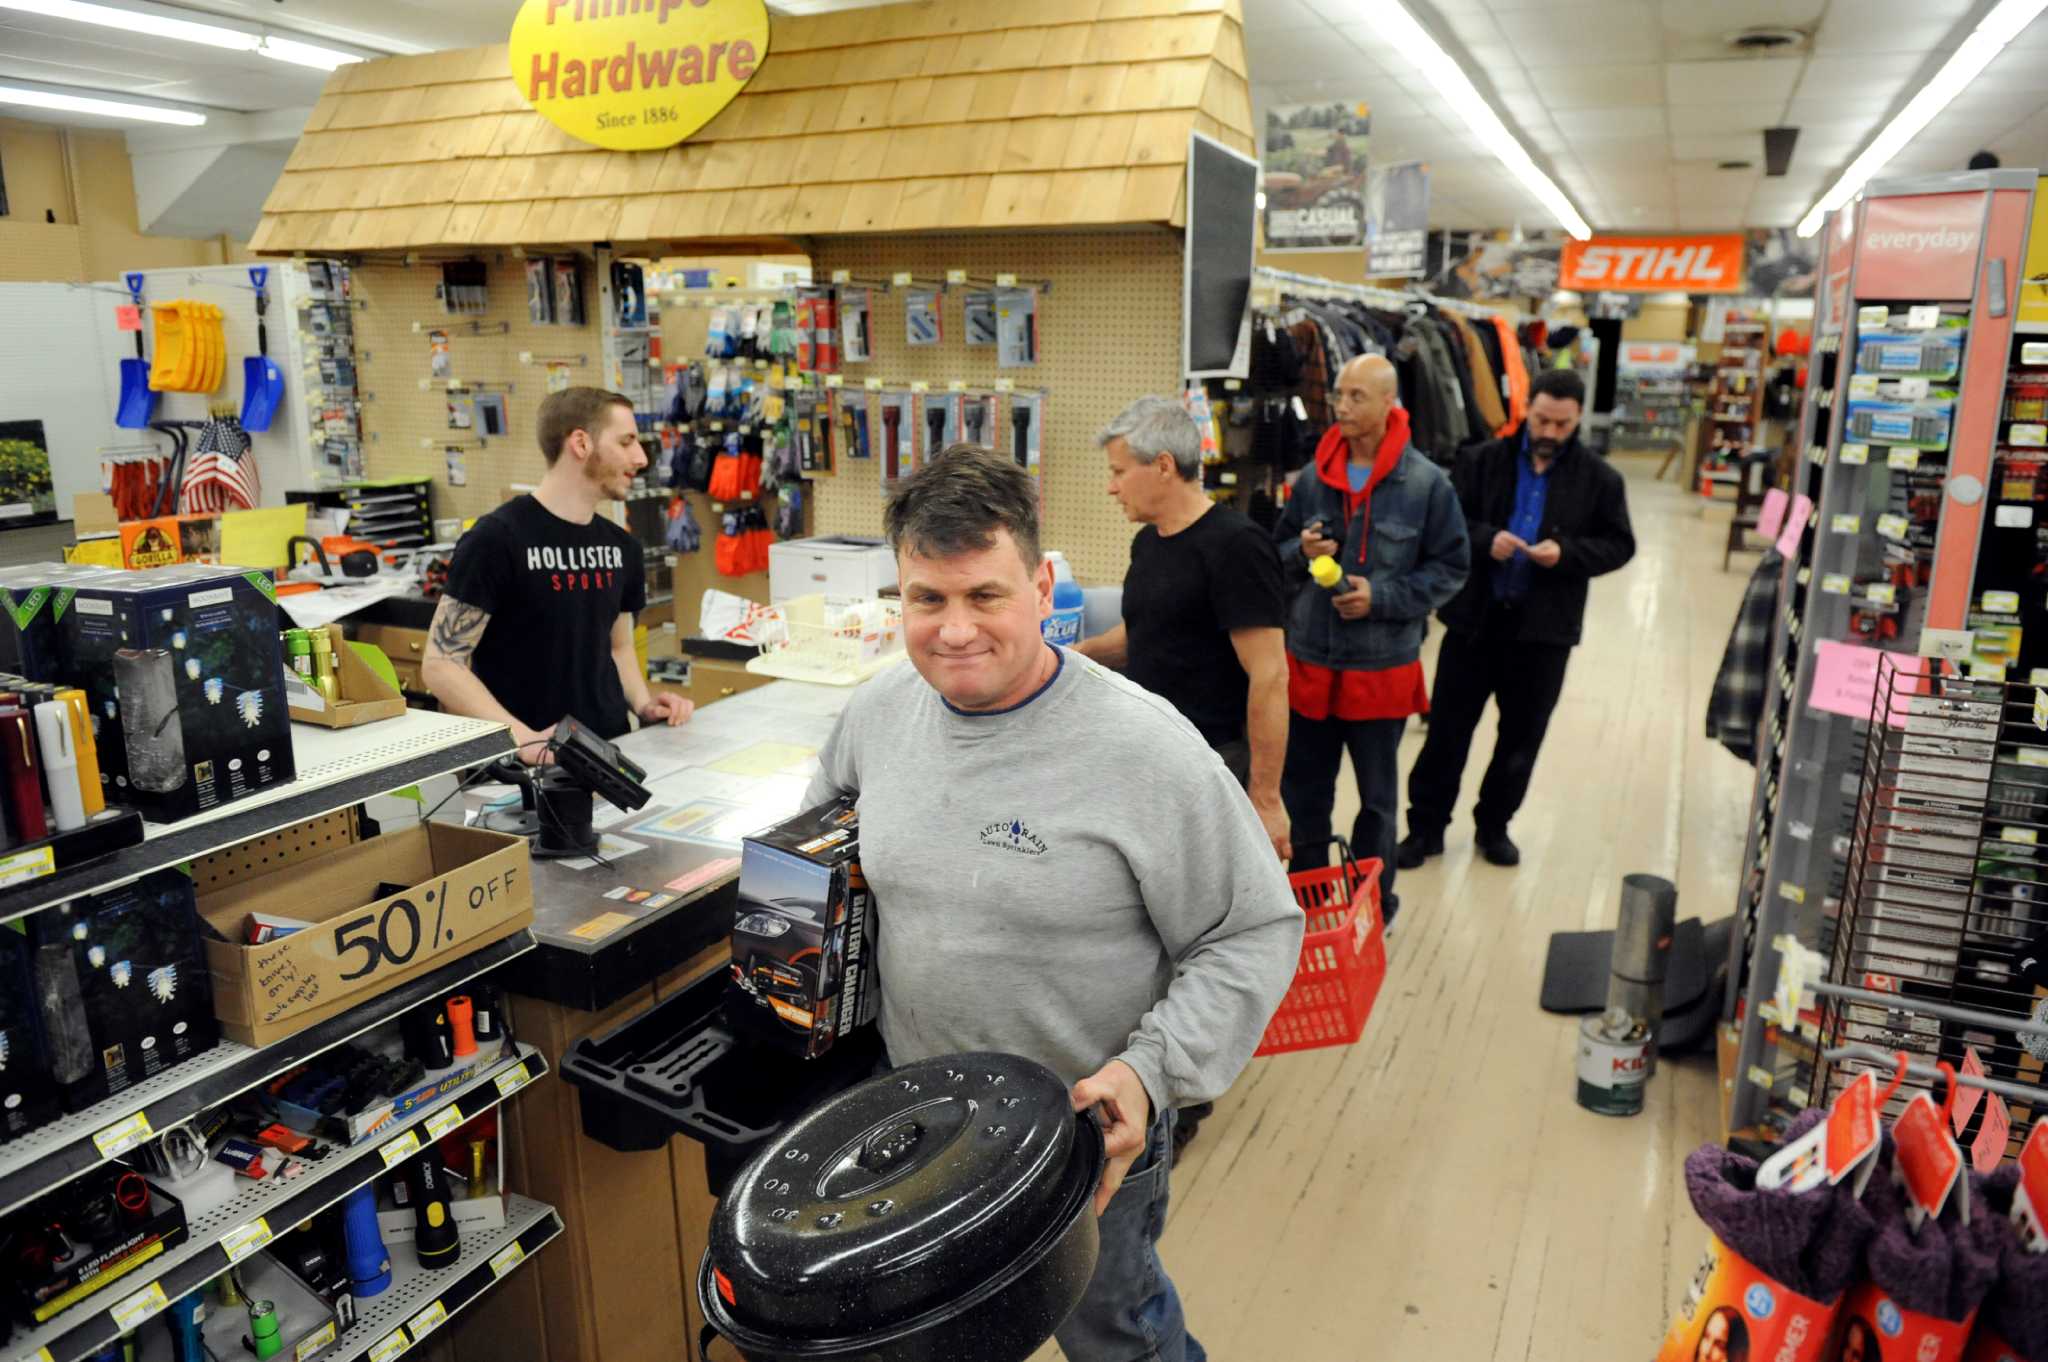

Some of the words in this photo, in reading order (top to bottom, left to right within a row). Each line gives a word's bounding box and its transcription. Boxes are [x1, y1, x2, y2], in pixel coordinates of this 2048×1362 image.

[529, 39, 755, 101] Hardware
[596, 112, 637, 130] Since
[643, 106, 679, 125] 1886
[1867, 229, 1974, 253] everyday
[1575, 245, 1723, 281] STIHL
[135, 553, 174, 564] GORILLA
[527, 546, 623, 570] HOLLISTER
[552, 572, 614, 592] SPORT
[980, 823, 1009, 840] AUTO
[1021, 829, 1048, 854] RAIN
[334, 881, 454, 981] 50%
[468, 868, 517, 909] OFF
[847, 893, 865, 961] BATTERY
[838, 963, 859, 1037] CHARGER
[100, 1232, 145, 1263] FLASHLIGHT
